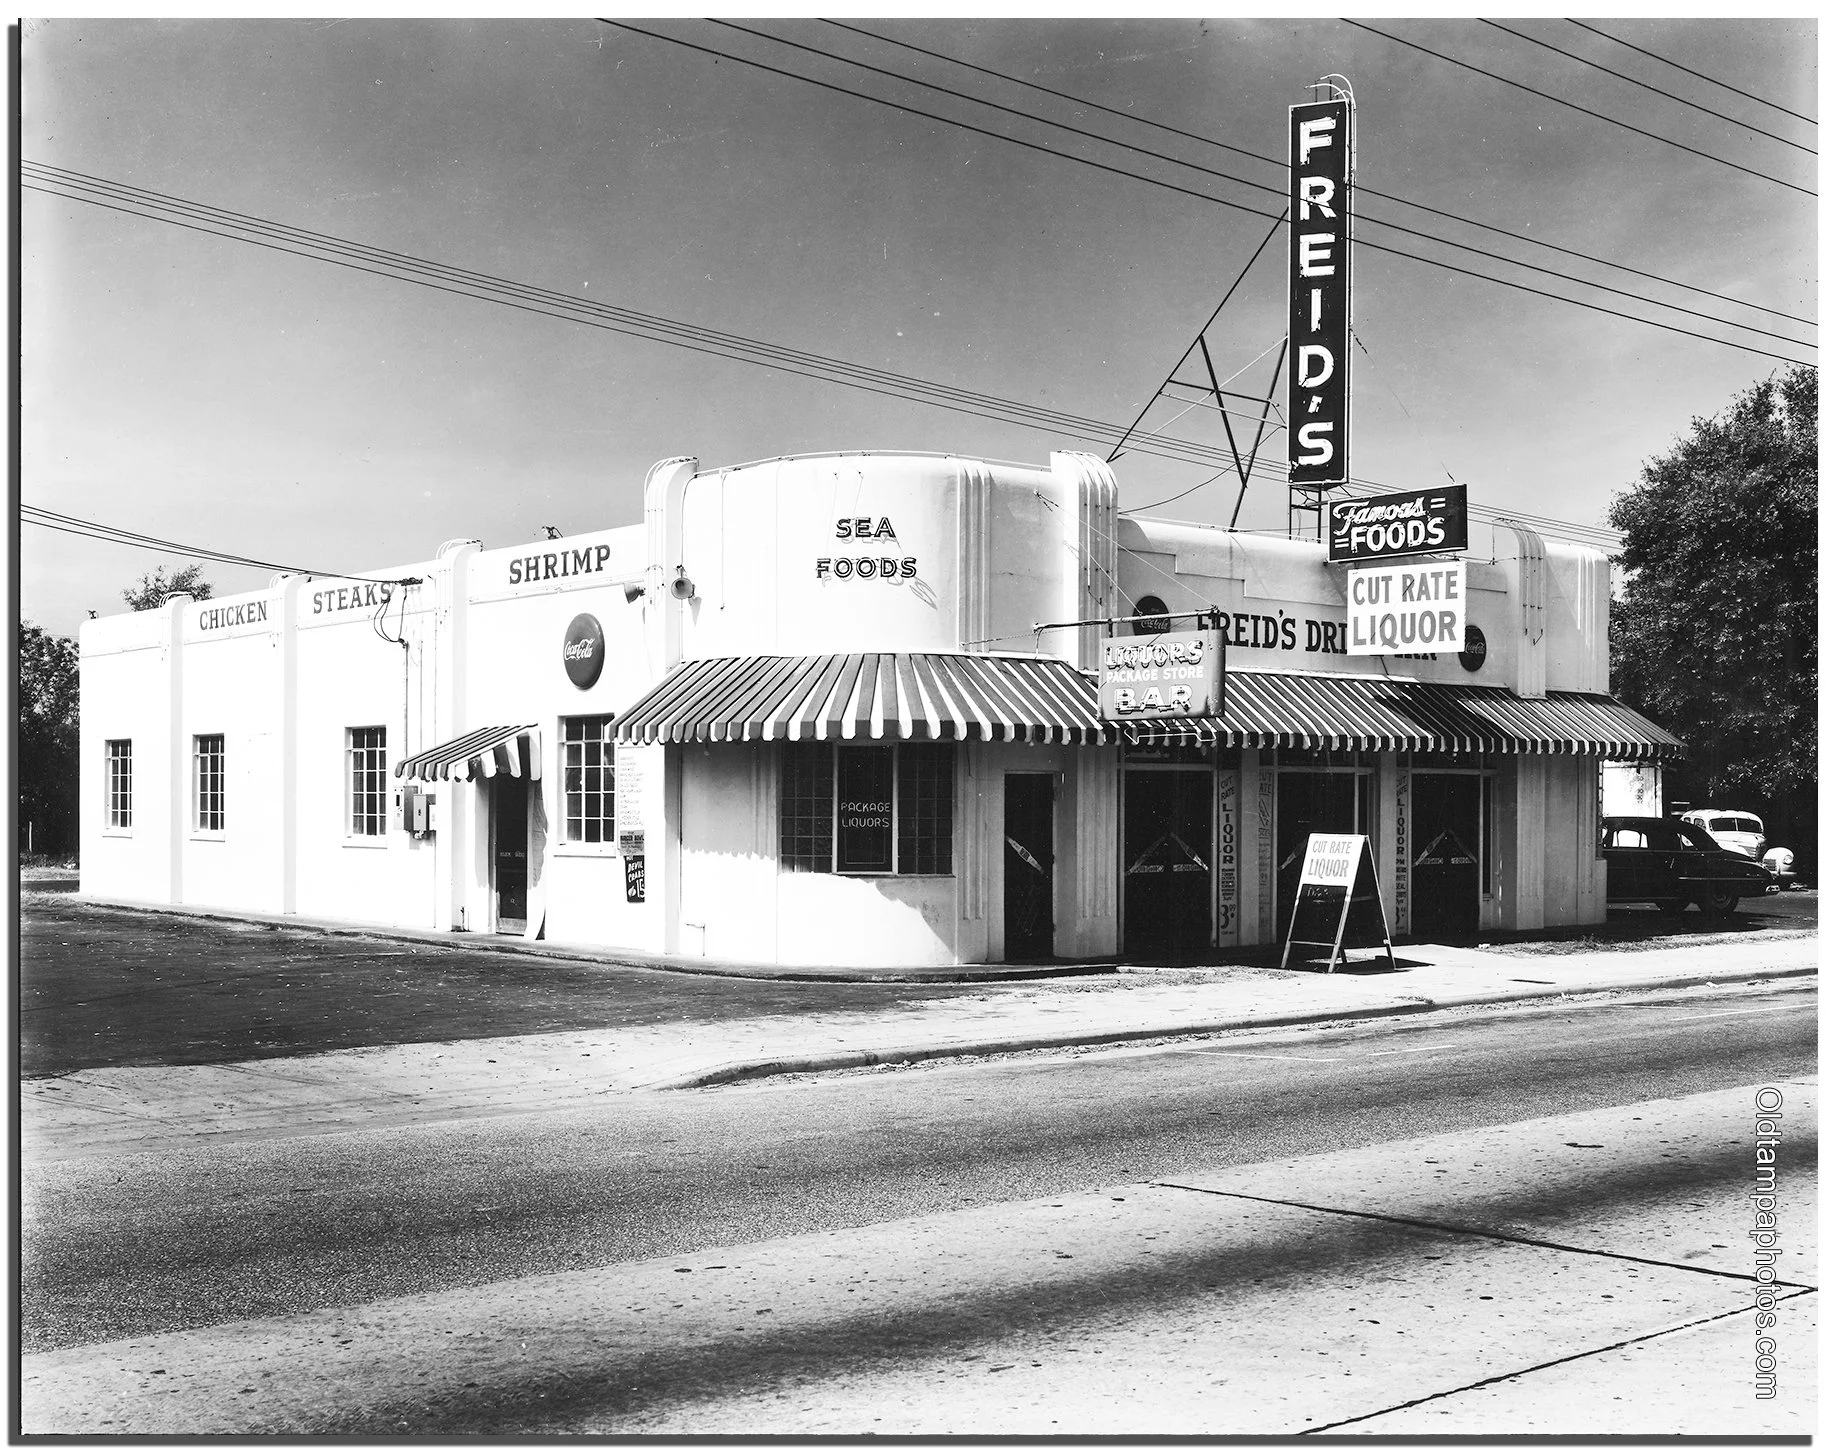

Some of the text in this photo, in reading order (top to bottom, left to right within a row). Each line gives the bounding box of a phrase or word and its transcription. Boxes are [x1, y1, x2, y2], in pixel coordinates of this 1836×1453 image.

[1299, 116, 1337, 467] FREID'S
[835, 517, 896, 538] SEA
[1351, 517, 1445, 553] FOODS
[509, 544, 611, 585] SHRIMP
[816, 557, 917, 579] FOODS
[313, 582, 391, 614] STEAKS
[1353, 570, 1458, 605] CUT RATE
[199, 600, 268, 630] CHICKEN
[1353, 610, 1457, 649] LIQUOR
[1104, 640, 1203, 669] LIQUORS
[1106, 666, 1204, 683] PACKAGE STORE
[1115, 684, 1193, 714] BAR
[841, 802, 891, 813] PACKAGE
[1221, 786, 1235, 801] RATE
[842, 817, 890, 828] LIQUORS
[1223, 803, 1233, 864] LIQUOR
[1397, 798, 1405, 855] LIQUOR
[1312, 841, 1352, 854] CUT RATE
[1308, 858, 1349, 879] LIQUOR
